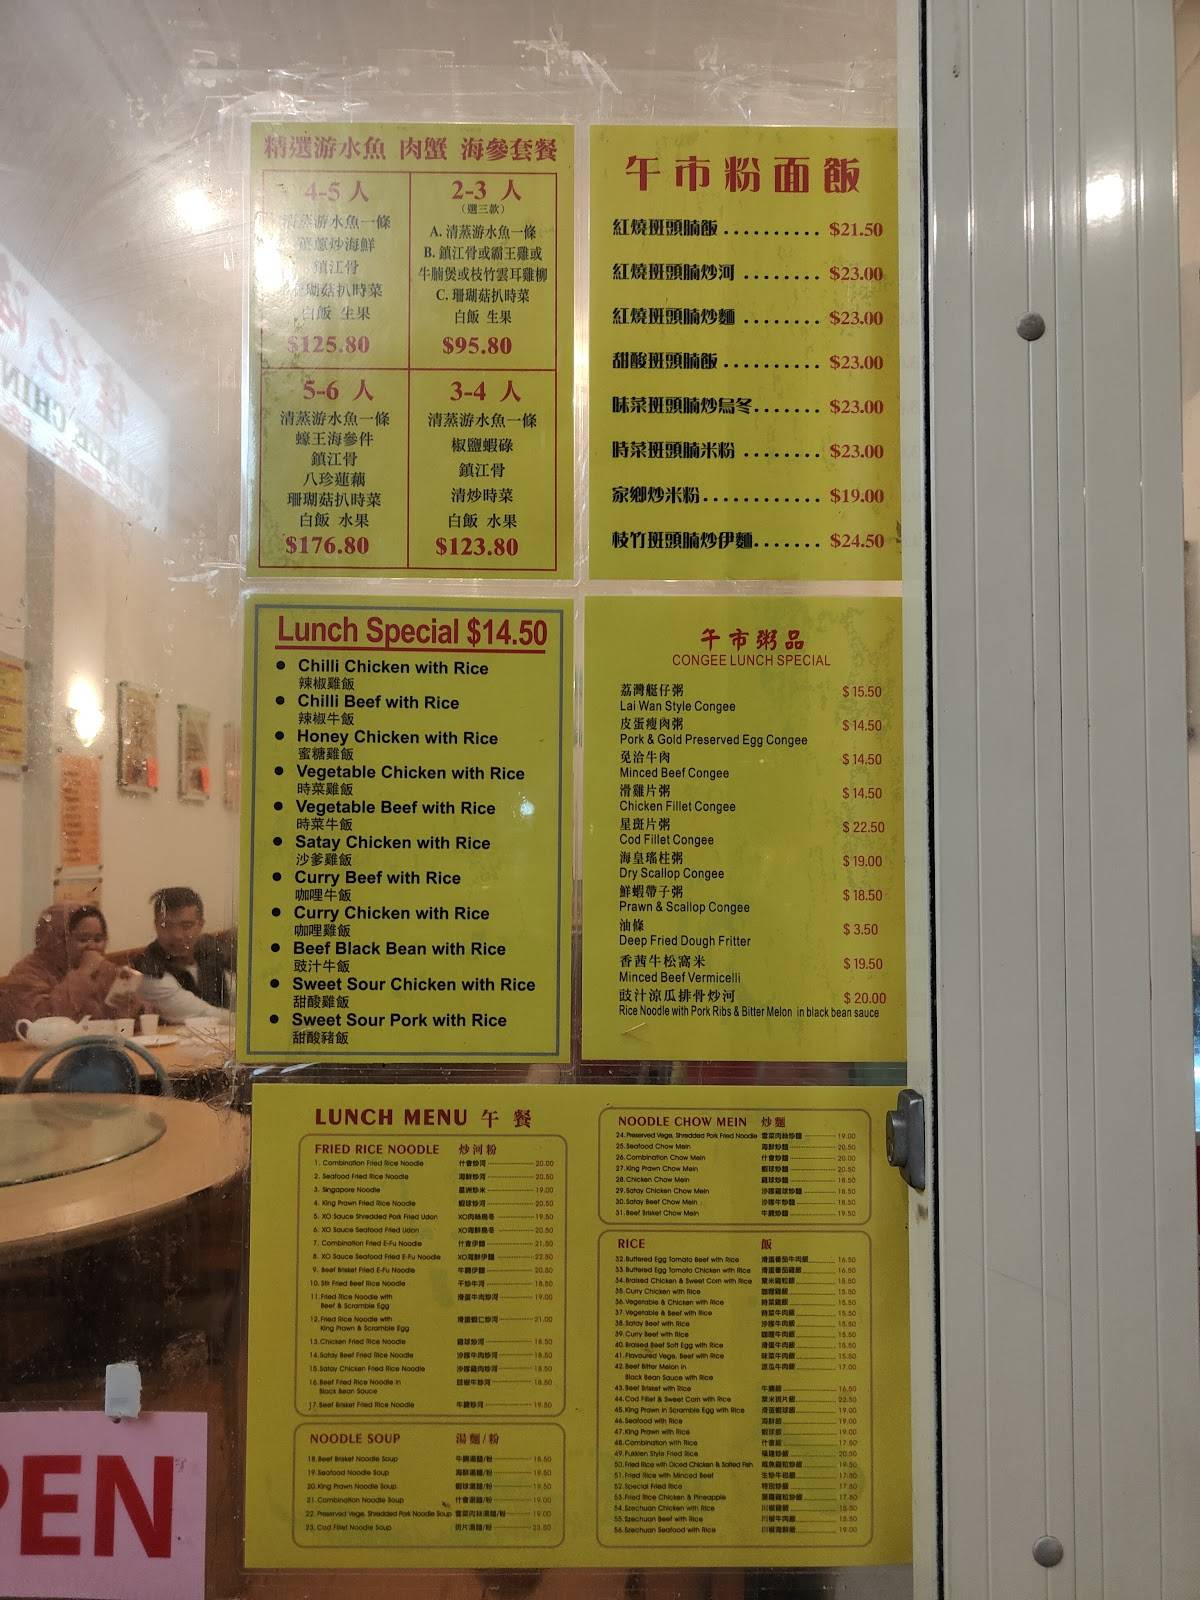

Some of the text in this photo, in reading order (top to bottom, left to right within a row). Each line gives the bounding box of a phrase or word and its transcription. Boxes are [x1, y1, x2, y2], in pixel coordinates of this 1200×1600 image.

[399, 136, 447, 161] 肉蟹
[460, 138, 557, 162] 海參套餐
[305, 181, 369, 201] 4-5 人
[452, 180, 521, 200] 2-3 人
[446, 224, 536, 240] 清蒸游水魚一條
[829, 222, 883, 237] $21.50
[830, 266, 883, 281] $23.00
[452, 288, 529, 303] 珊瑚菇扒時菜
[455, 310, 512, 324] 白飯 生果
[830, 311, 883, 326] $23.00
[288, 336, 369, 353] $125.80
[443, 337, 512, 354] $95.80
[830, 354, 883, 370] $23.00
[303, 380, 373, 401] 5-6 人
[451, 380, 521, 401] 3-4 人
[830, 399, 884, 414] $23.00
[280, 411, 390, 426] 清蒸游水魚一條
[428, 412, 537, 428] 清蒸游水魚一條
[830, 444, 884, 459] $23.00
[311, 452, 358, 467] 鎮江骨
[459, 463, 505, 477] 鎮江骨
[303, 472, 366, 487] 八珍蓮藕
[288, 492, 381, 507] 珊瑚菇扒時菜
[452, 488, 513, 504] 清炒時菜
[612, 486, 884, 503] 家鄉炒米粉 $19.00
[300, 513, 369, 528] 白飯 水果
[449, 514, 517, 529] 白飯 水果
[285, 536, 369, 554] $176.80
[436, 537, 518, 556] $123.80
[831, 533, 884, 548] $24.50
[278, 616, 548, 648] Lunch Special $14.50
[701, 628, 805, 651] 午市粥品
[299, 659, 488, 675] Chilli Chicken with Rice
[672, 654, 831, 666] CONGEE LUNCH SPECIAL
[299, 676, 354, 691] 辣椒雞飯
[621, 700, 735, 713] Lai Wan Style Congee
[621, 733, 807, 748] Pork & Gold Preserved Egg Congee
[296, 835, 490, 851] Satay Chicken with Rice
[620, 834, 713, 847] Cod Fillet Congee
[296, 853, 352, 866] 沙爹雞飯
[294, 941, 506, 956] Beef Black Bean with Rice
[620, 935, 751, 948] Deep Fried Dough Fritter
[294, 959, 350, 973] 豉汁牛飯
[619, 1005, 879, 1018] Rice Noodle with Pork Ribs & Bitter Melon in black bean sauce
[292, 1013, 507, 1027] Sweet Sour Pork with Rice
[316, 1109, 467, 1126] LUNCH MENU
[619, 1116, 746, 1127] NOODLE CHOW MEIN
[315, 1144, 439, 1155] FRIED RICE NOODLE
[618, 1239, 645, 1248] RICE
[310, 1433, 400, 1444] NOODLE SOUP
[0, 1454, 175, 1558] EN
